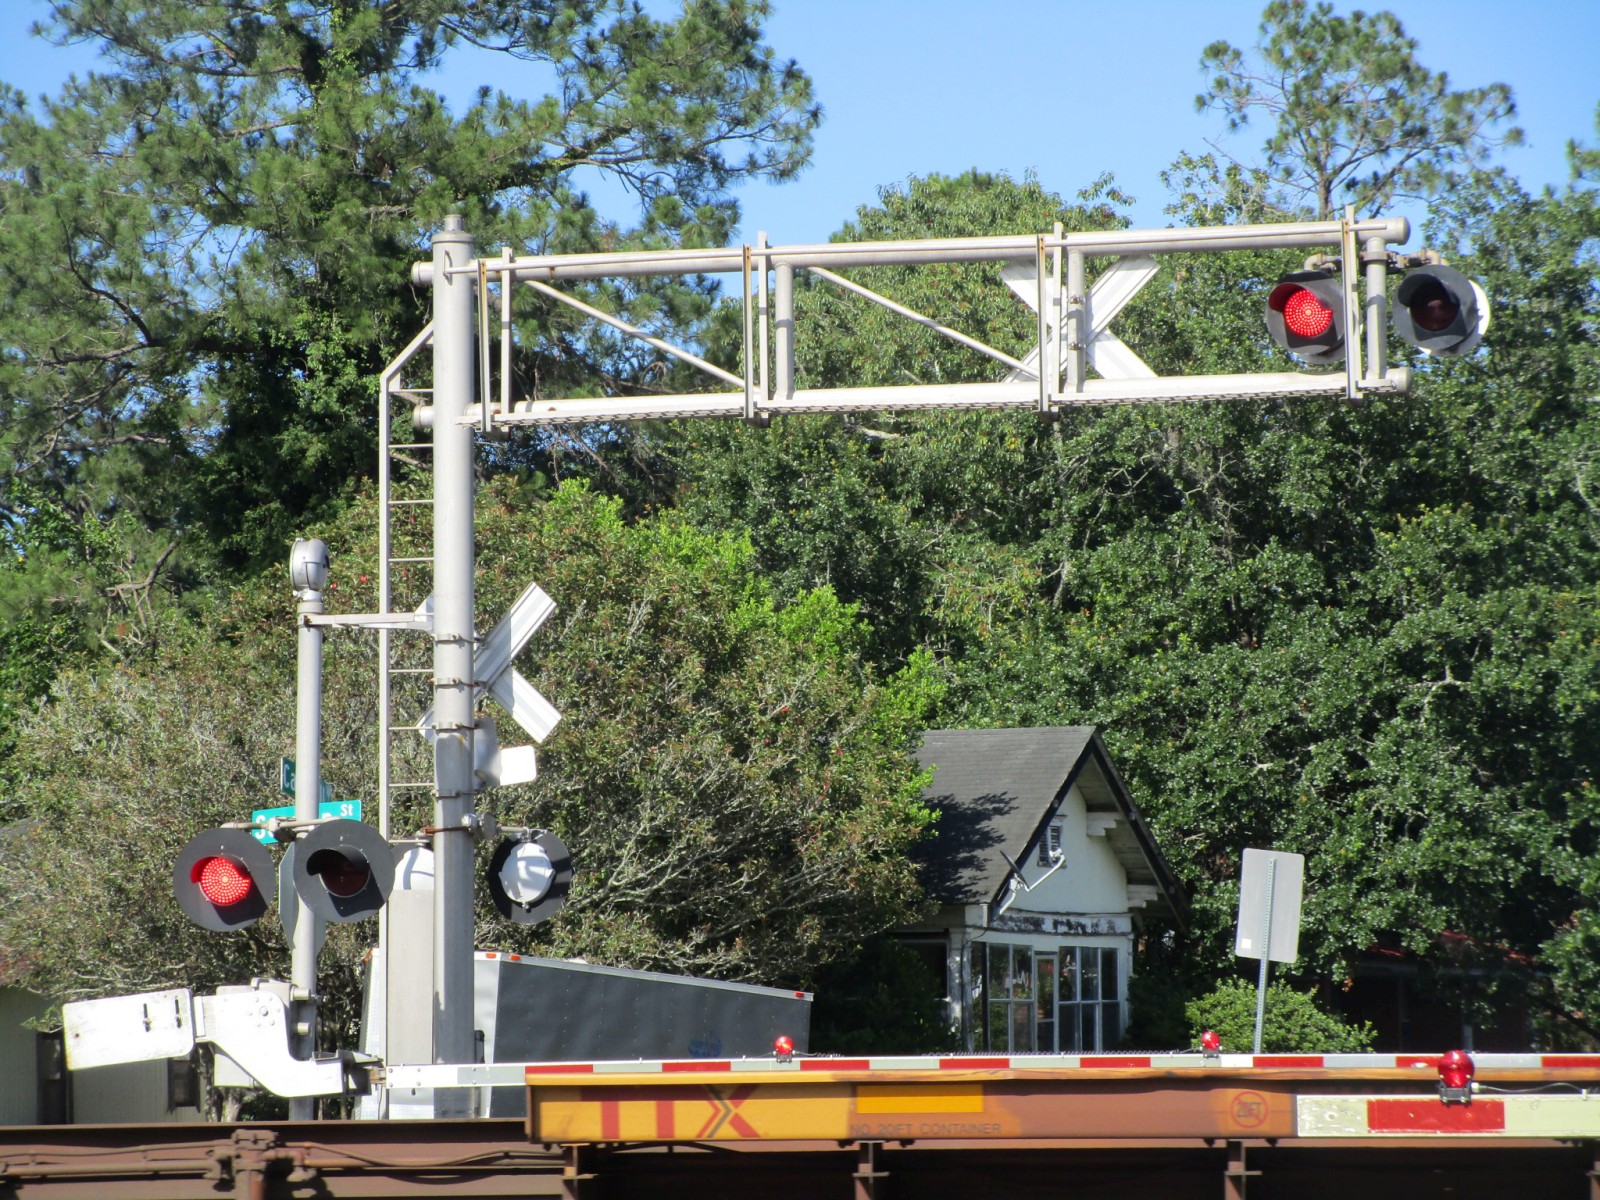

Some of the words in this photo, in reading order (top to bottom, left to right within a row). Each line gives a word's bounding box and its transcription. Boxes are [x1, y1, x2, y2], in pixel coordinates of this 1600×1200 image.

[340, 803, 354, 817] St
[581, 1084, 762, 1139] TTX
[850, 1123, 871, 1136] NO
[878, 1123, 913, 1136] 20FT
[919, 1123, 1002, 1136] CONTAINER
